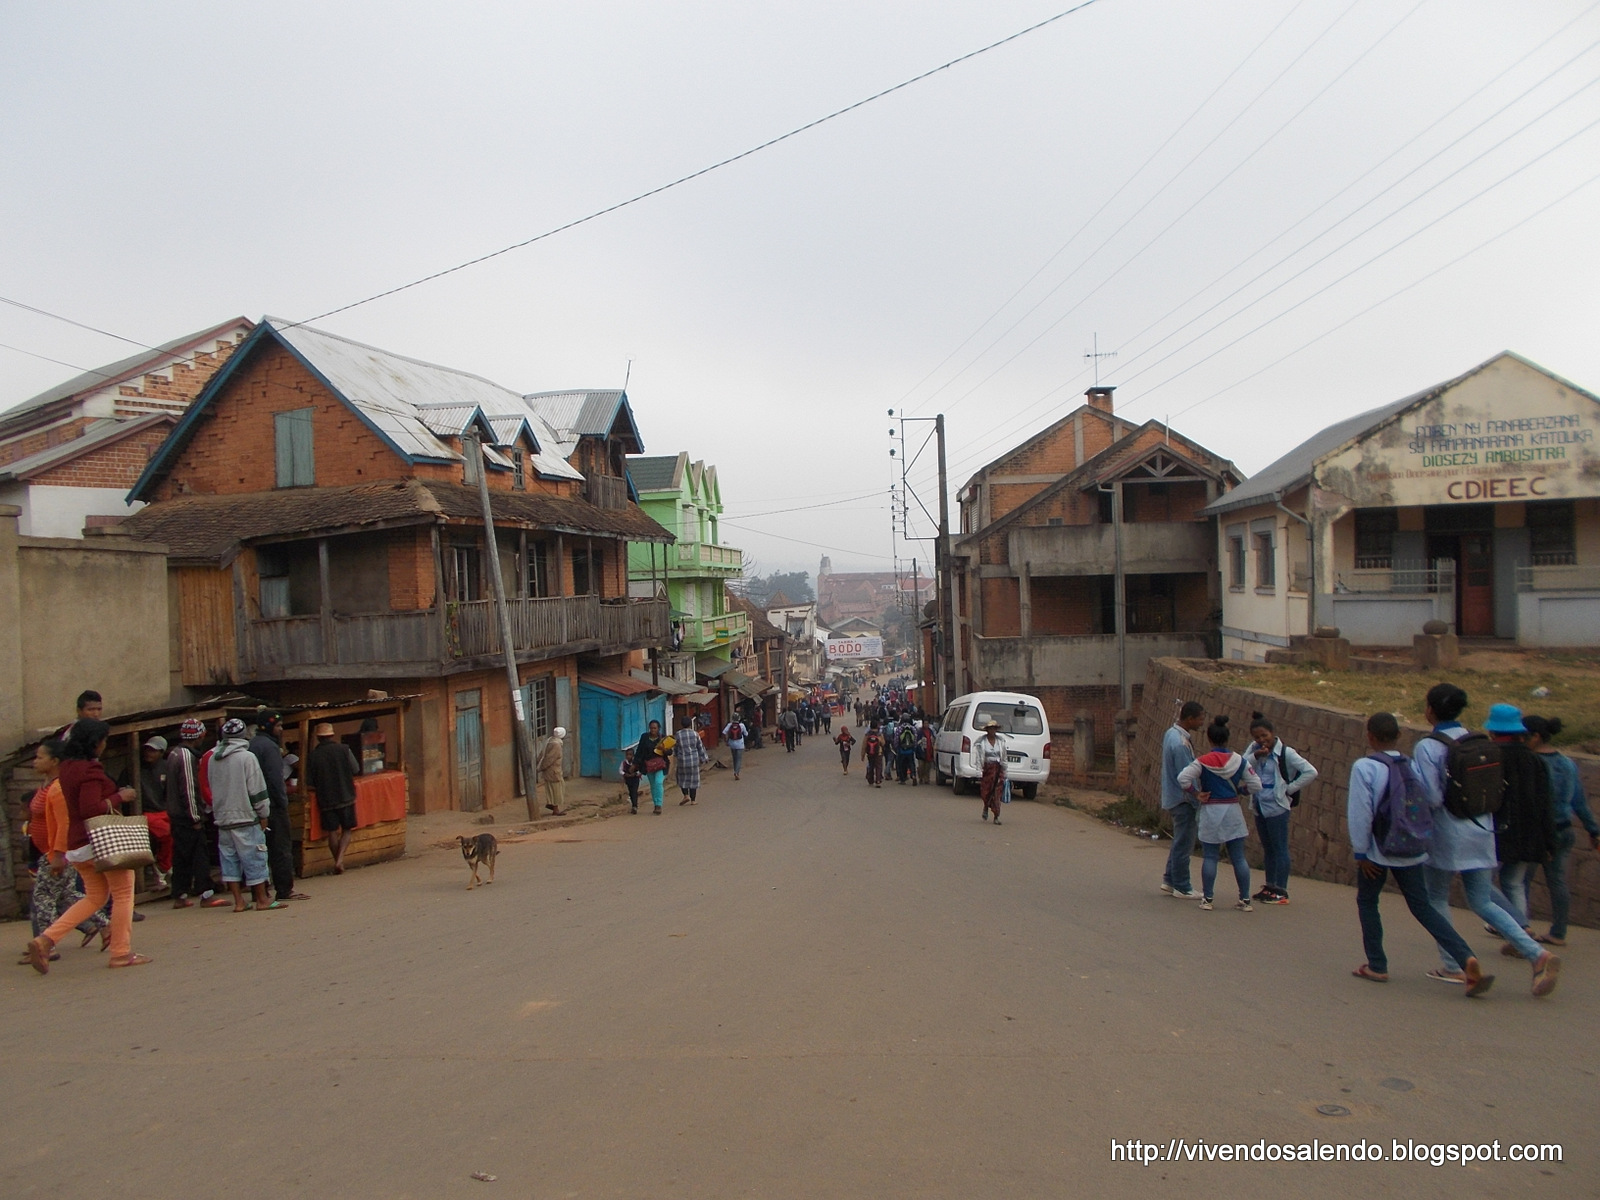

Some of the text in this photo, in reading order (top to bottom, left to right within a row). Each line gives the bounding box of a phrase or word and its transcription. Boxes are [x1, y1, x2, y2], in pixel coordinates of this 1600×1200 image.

[1409, 441, 1426, 454] SY
[1423, 446, 1566, 467] DIOSEZY AMBOSITRA
[1447, 476, 1548, 500] CDIEEC
[829, 643, 861, 653] BODO
